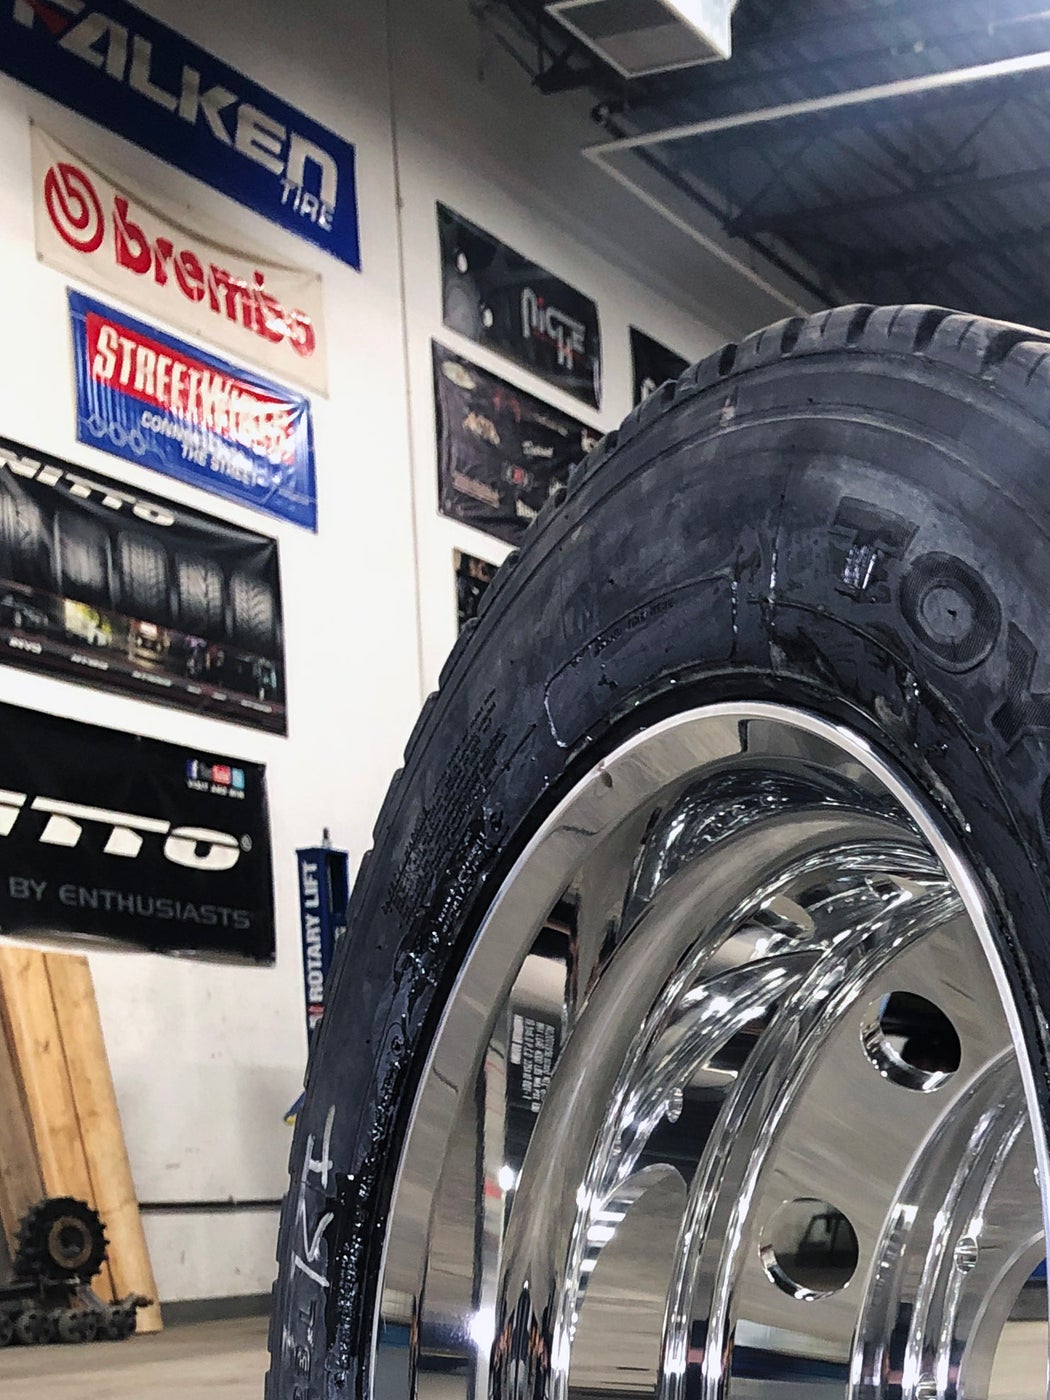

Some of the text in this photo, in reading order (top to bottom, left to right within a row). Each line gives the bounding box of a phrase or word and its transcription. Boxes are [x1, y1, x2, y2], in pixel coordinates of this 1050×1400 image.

[281, 178, 334, 232] TIRE
[9, 875, 250, 930] BY ENTHUSIASTS
[302, 860, 324, 1002] ROTARY LIFT
